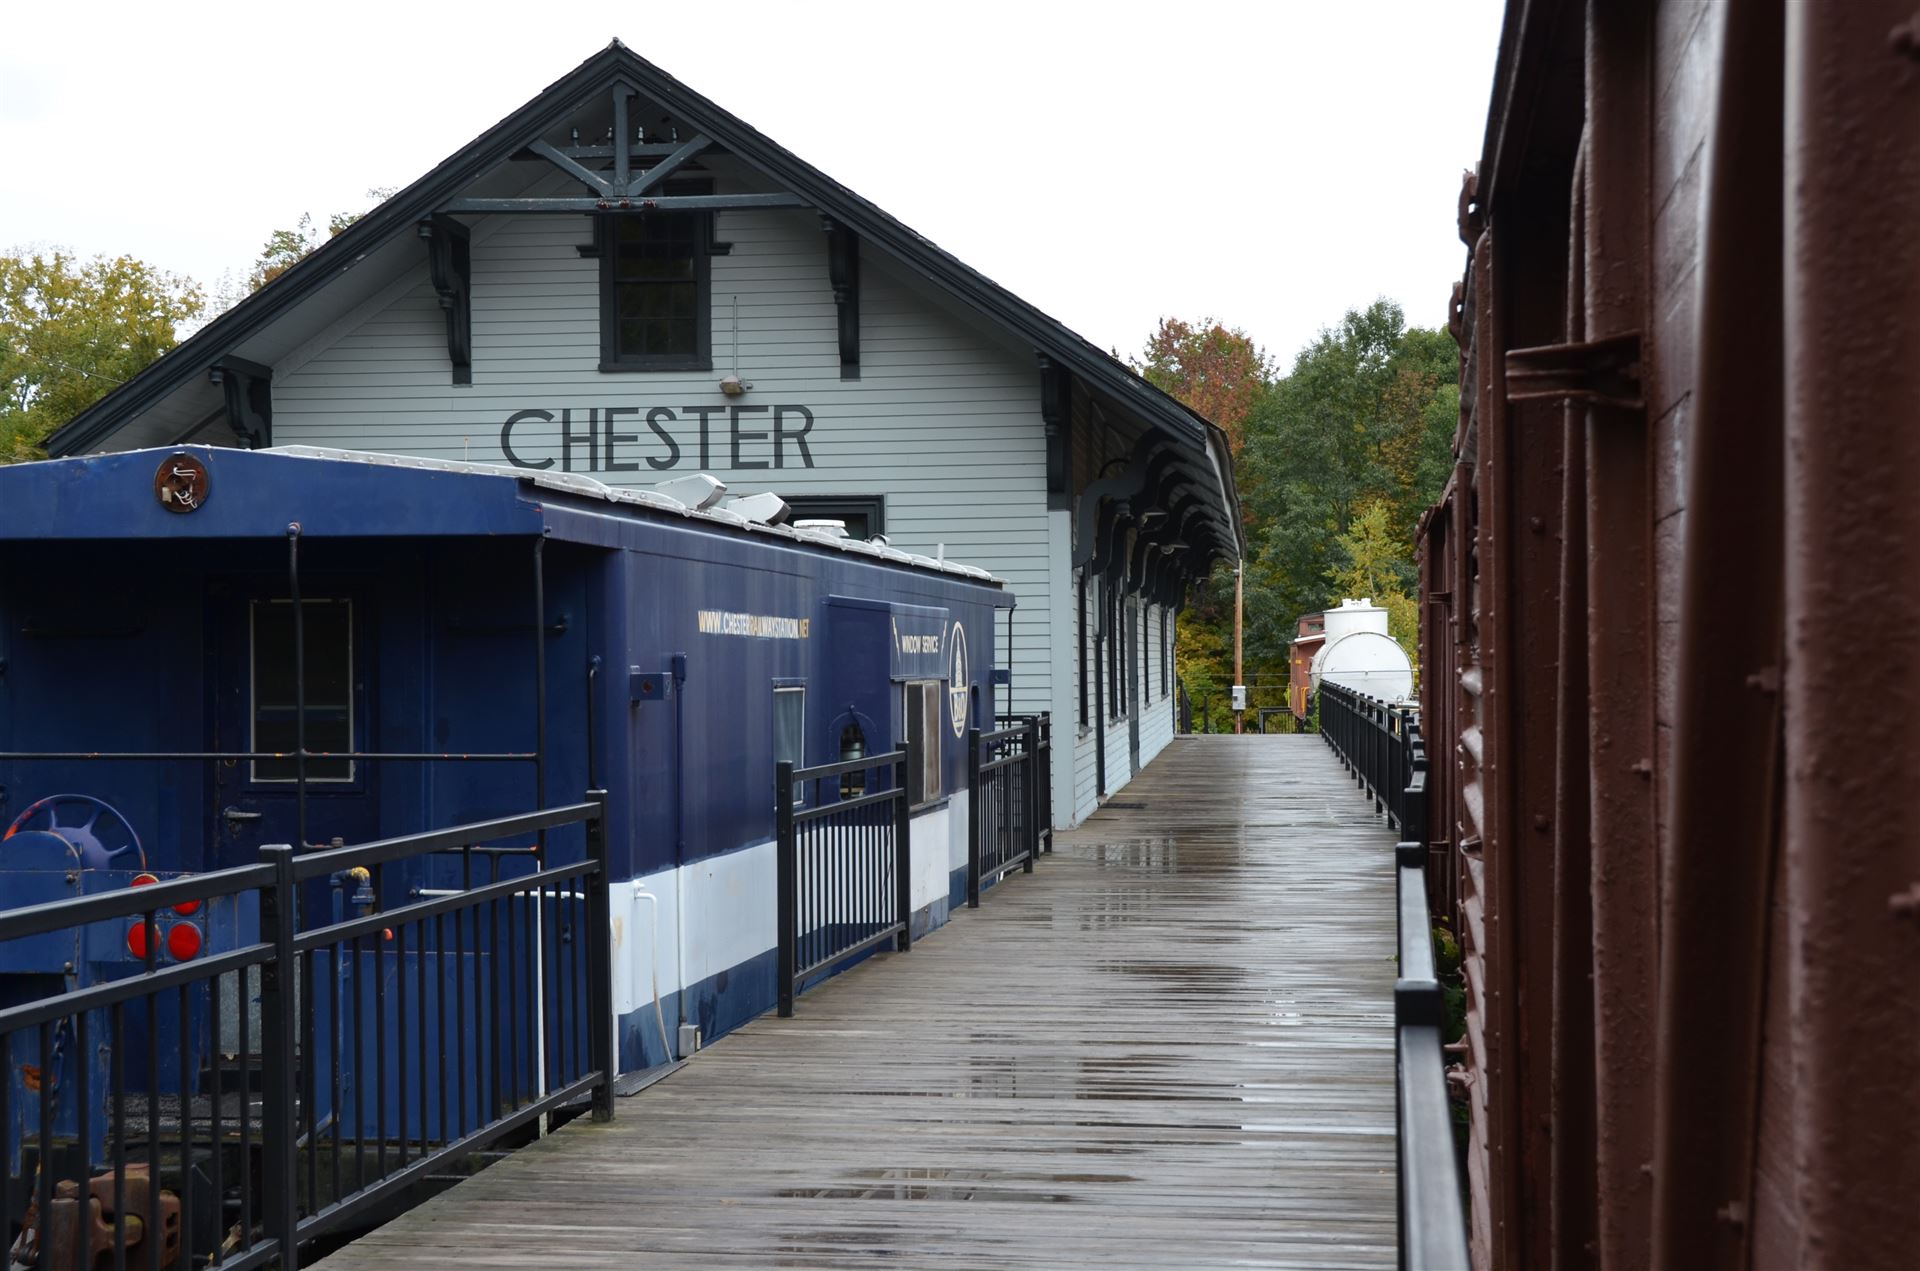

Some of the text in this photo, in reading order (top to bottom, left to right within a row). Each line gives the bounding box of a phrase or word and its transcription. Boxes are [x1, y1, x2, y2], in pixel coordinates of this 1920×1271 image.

[501, 404, 814, 472] CHESTER
[902, 635, 938, 653] WINDOW SERVICE
